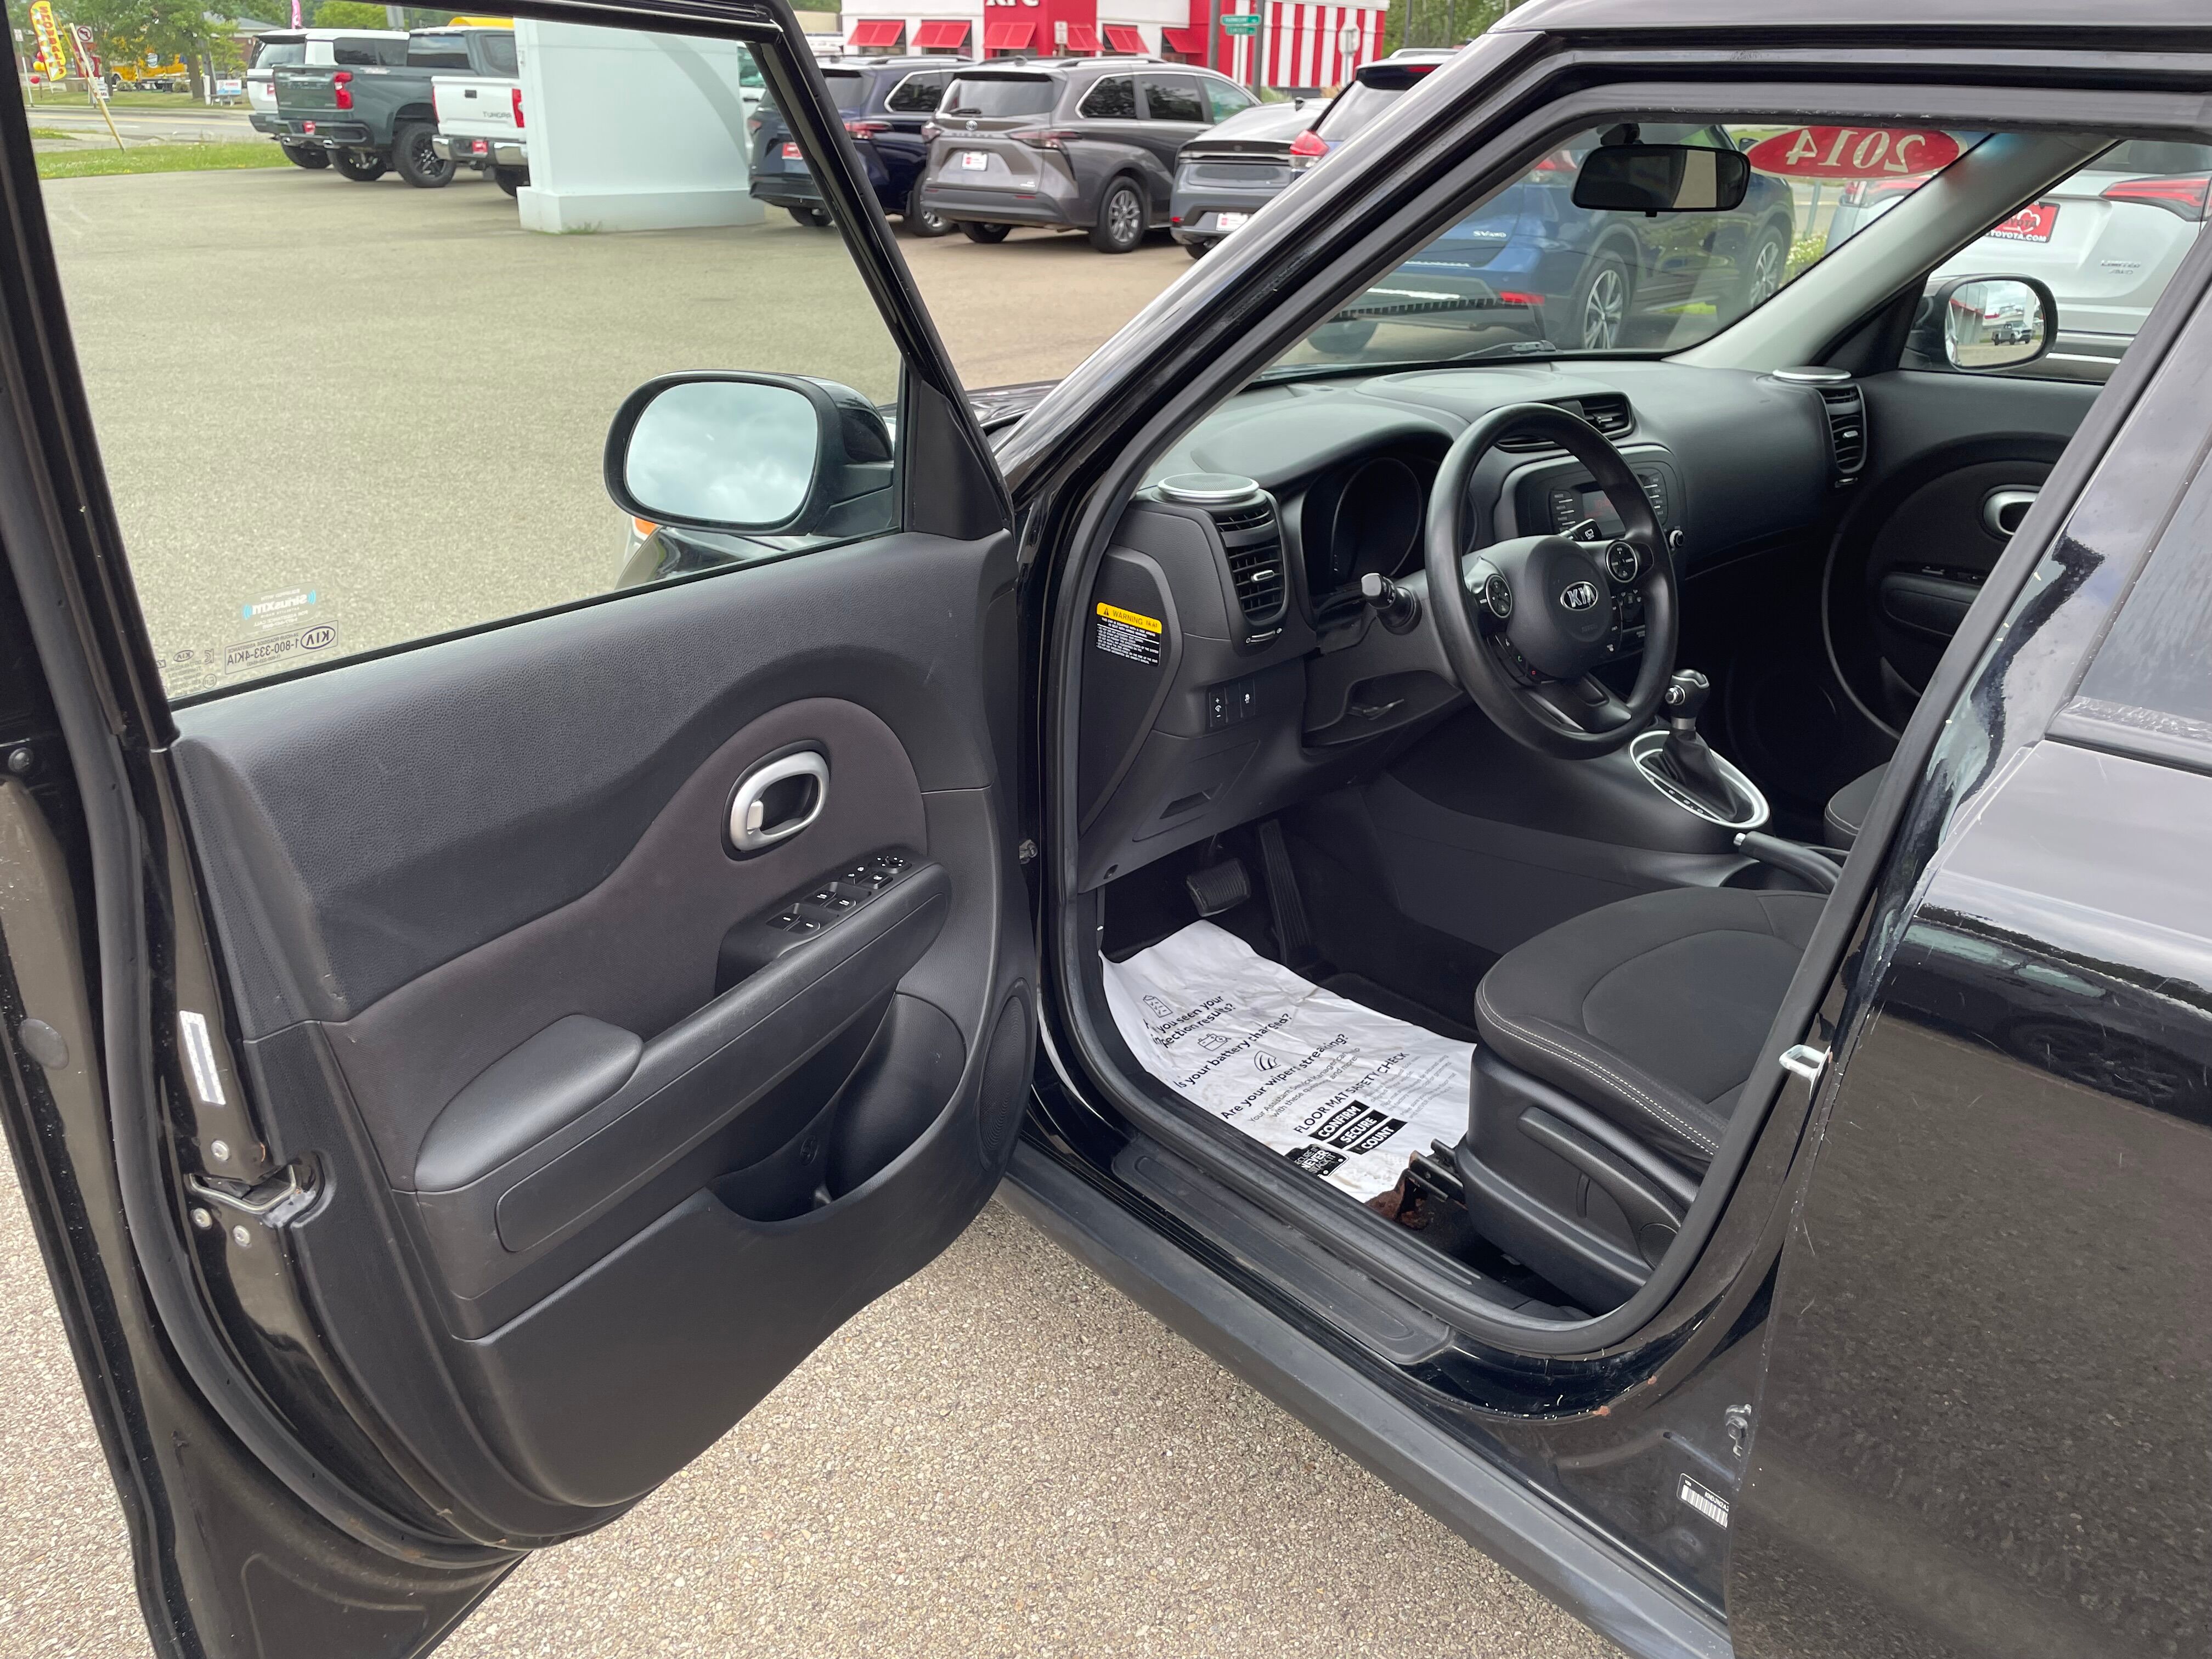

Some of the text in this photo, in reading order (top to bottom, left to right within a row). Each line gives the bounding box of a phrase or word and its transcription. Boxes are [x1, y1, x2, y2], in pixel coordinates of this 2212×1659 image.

[1567, 584, 1595, 608] KIA
[1113, 610, 1143, 625] WARNING
[1158, 1020, 1177, 1034] you
[1178, 1008, 1202, 1024] seen
[1200, 996, 1224, 1010] your
[1172, 1080, 1187, 1088] Is
[1185, 1065, 1211, 1085] your
[1207, 1040, 1251, 1066] battery
[1221, 1106, 1243, 1120] Are
[1240, 1087, 1267, 1107] your
[1272, 1104, 1288, 1118] with
[1288, 1092, 1305, 1106] these
[1330, 1068, 1344, 1080] and
[1293, 1107, 1330, 1134] FLOOR
[1325, 1092, 1350, 1112] MAT
[1377, 1052, 1410, 1074] CHECK
[1248, 1111, 1265, 1123] Your
[1318, 1105, 1362, 1137] CONFIRM
[1340, 1117, 1378, 1143] SECURE
[1361, 1126, 1395, 1149] COUNT
[1294, 1148, 1313, 1165] ECURE
[1301, 1150, 1329, 1170] NEVER
